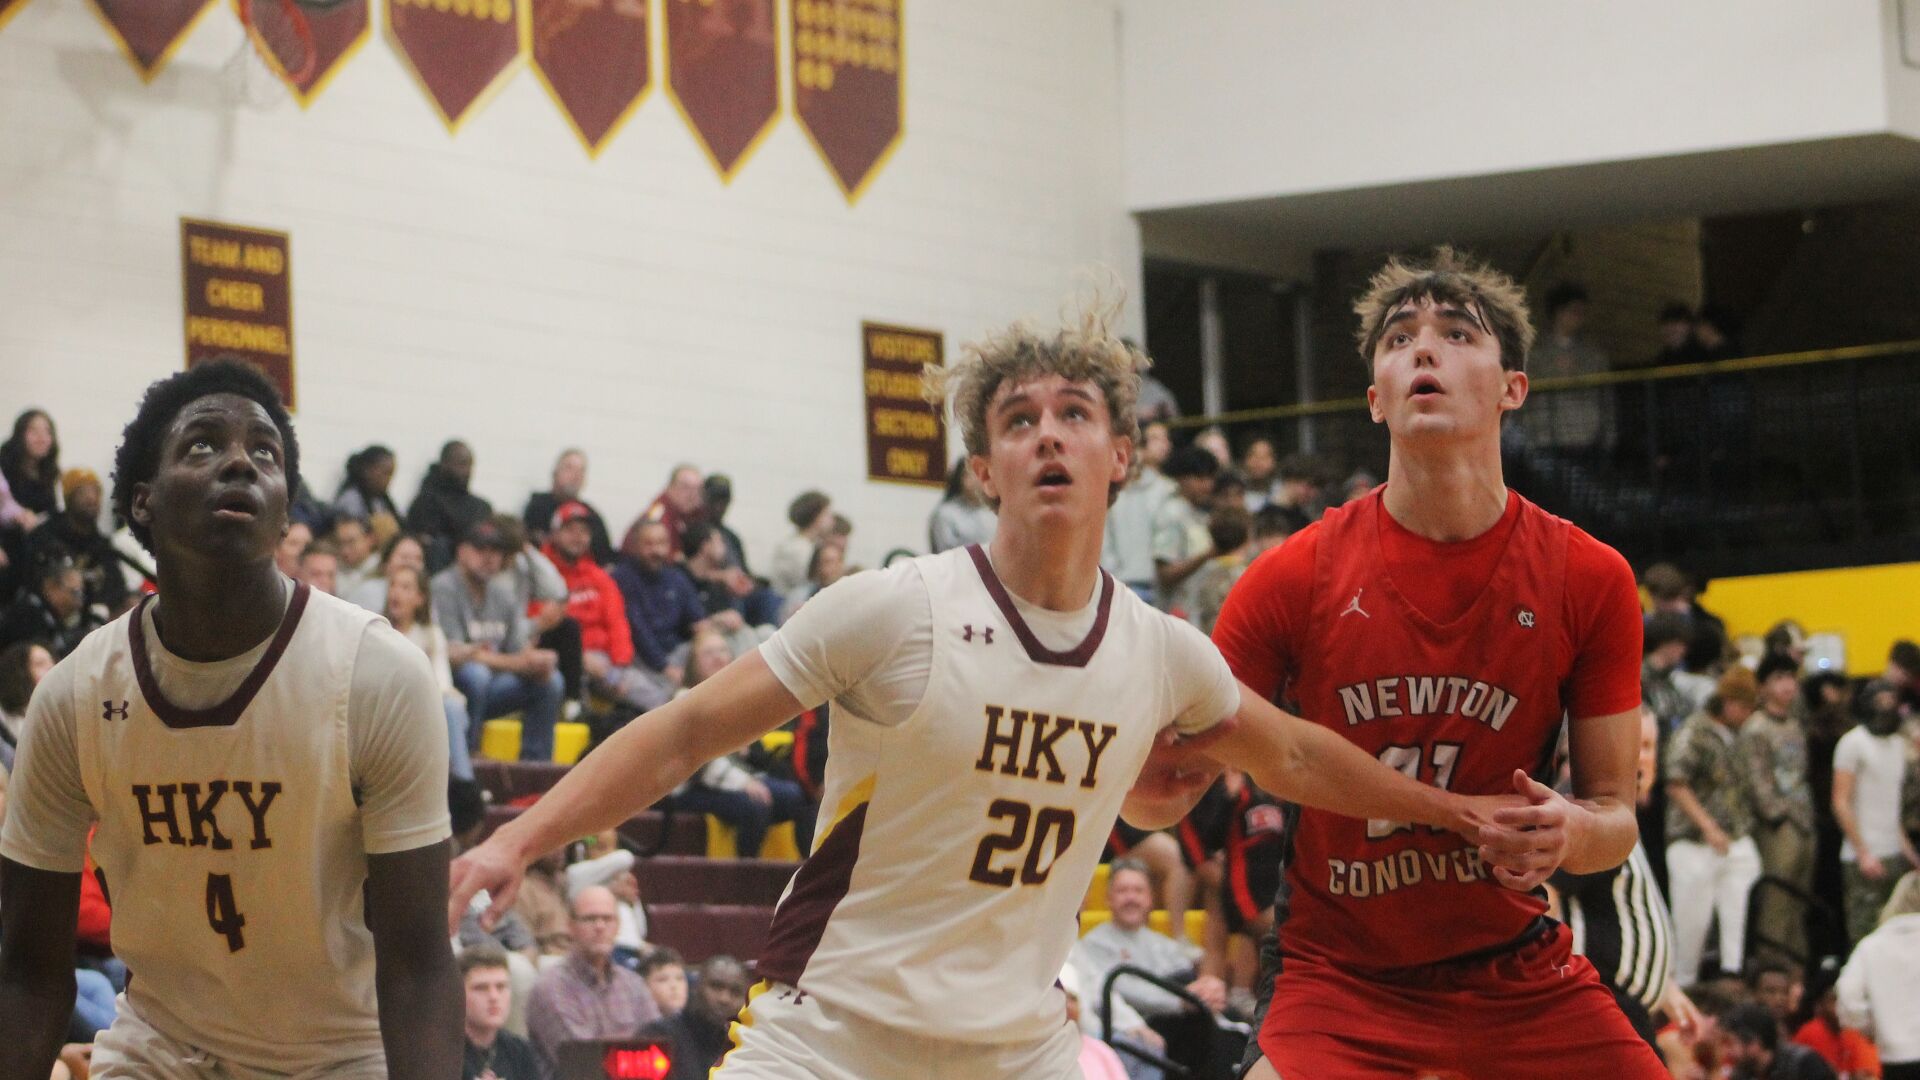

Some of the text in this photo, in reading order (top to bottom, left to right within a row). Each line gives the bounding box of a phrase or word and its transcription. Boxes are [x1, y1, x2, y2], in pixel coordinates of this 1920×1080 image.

[244, 243, 284, 276] AND
[206, 277, 264, 313] CHEER
[189, 316, 289, 355] PERSONNEL
[1337, 676, 1519, 732] NEWTON
[975, 705, 1117, 788] HKY
[132, 780, 282, 850] HKY
[969, 798, 1075, 887] 20
[206, 872, 245, 953] 4
